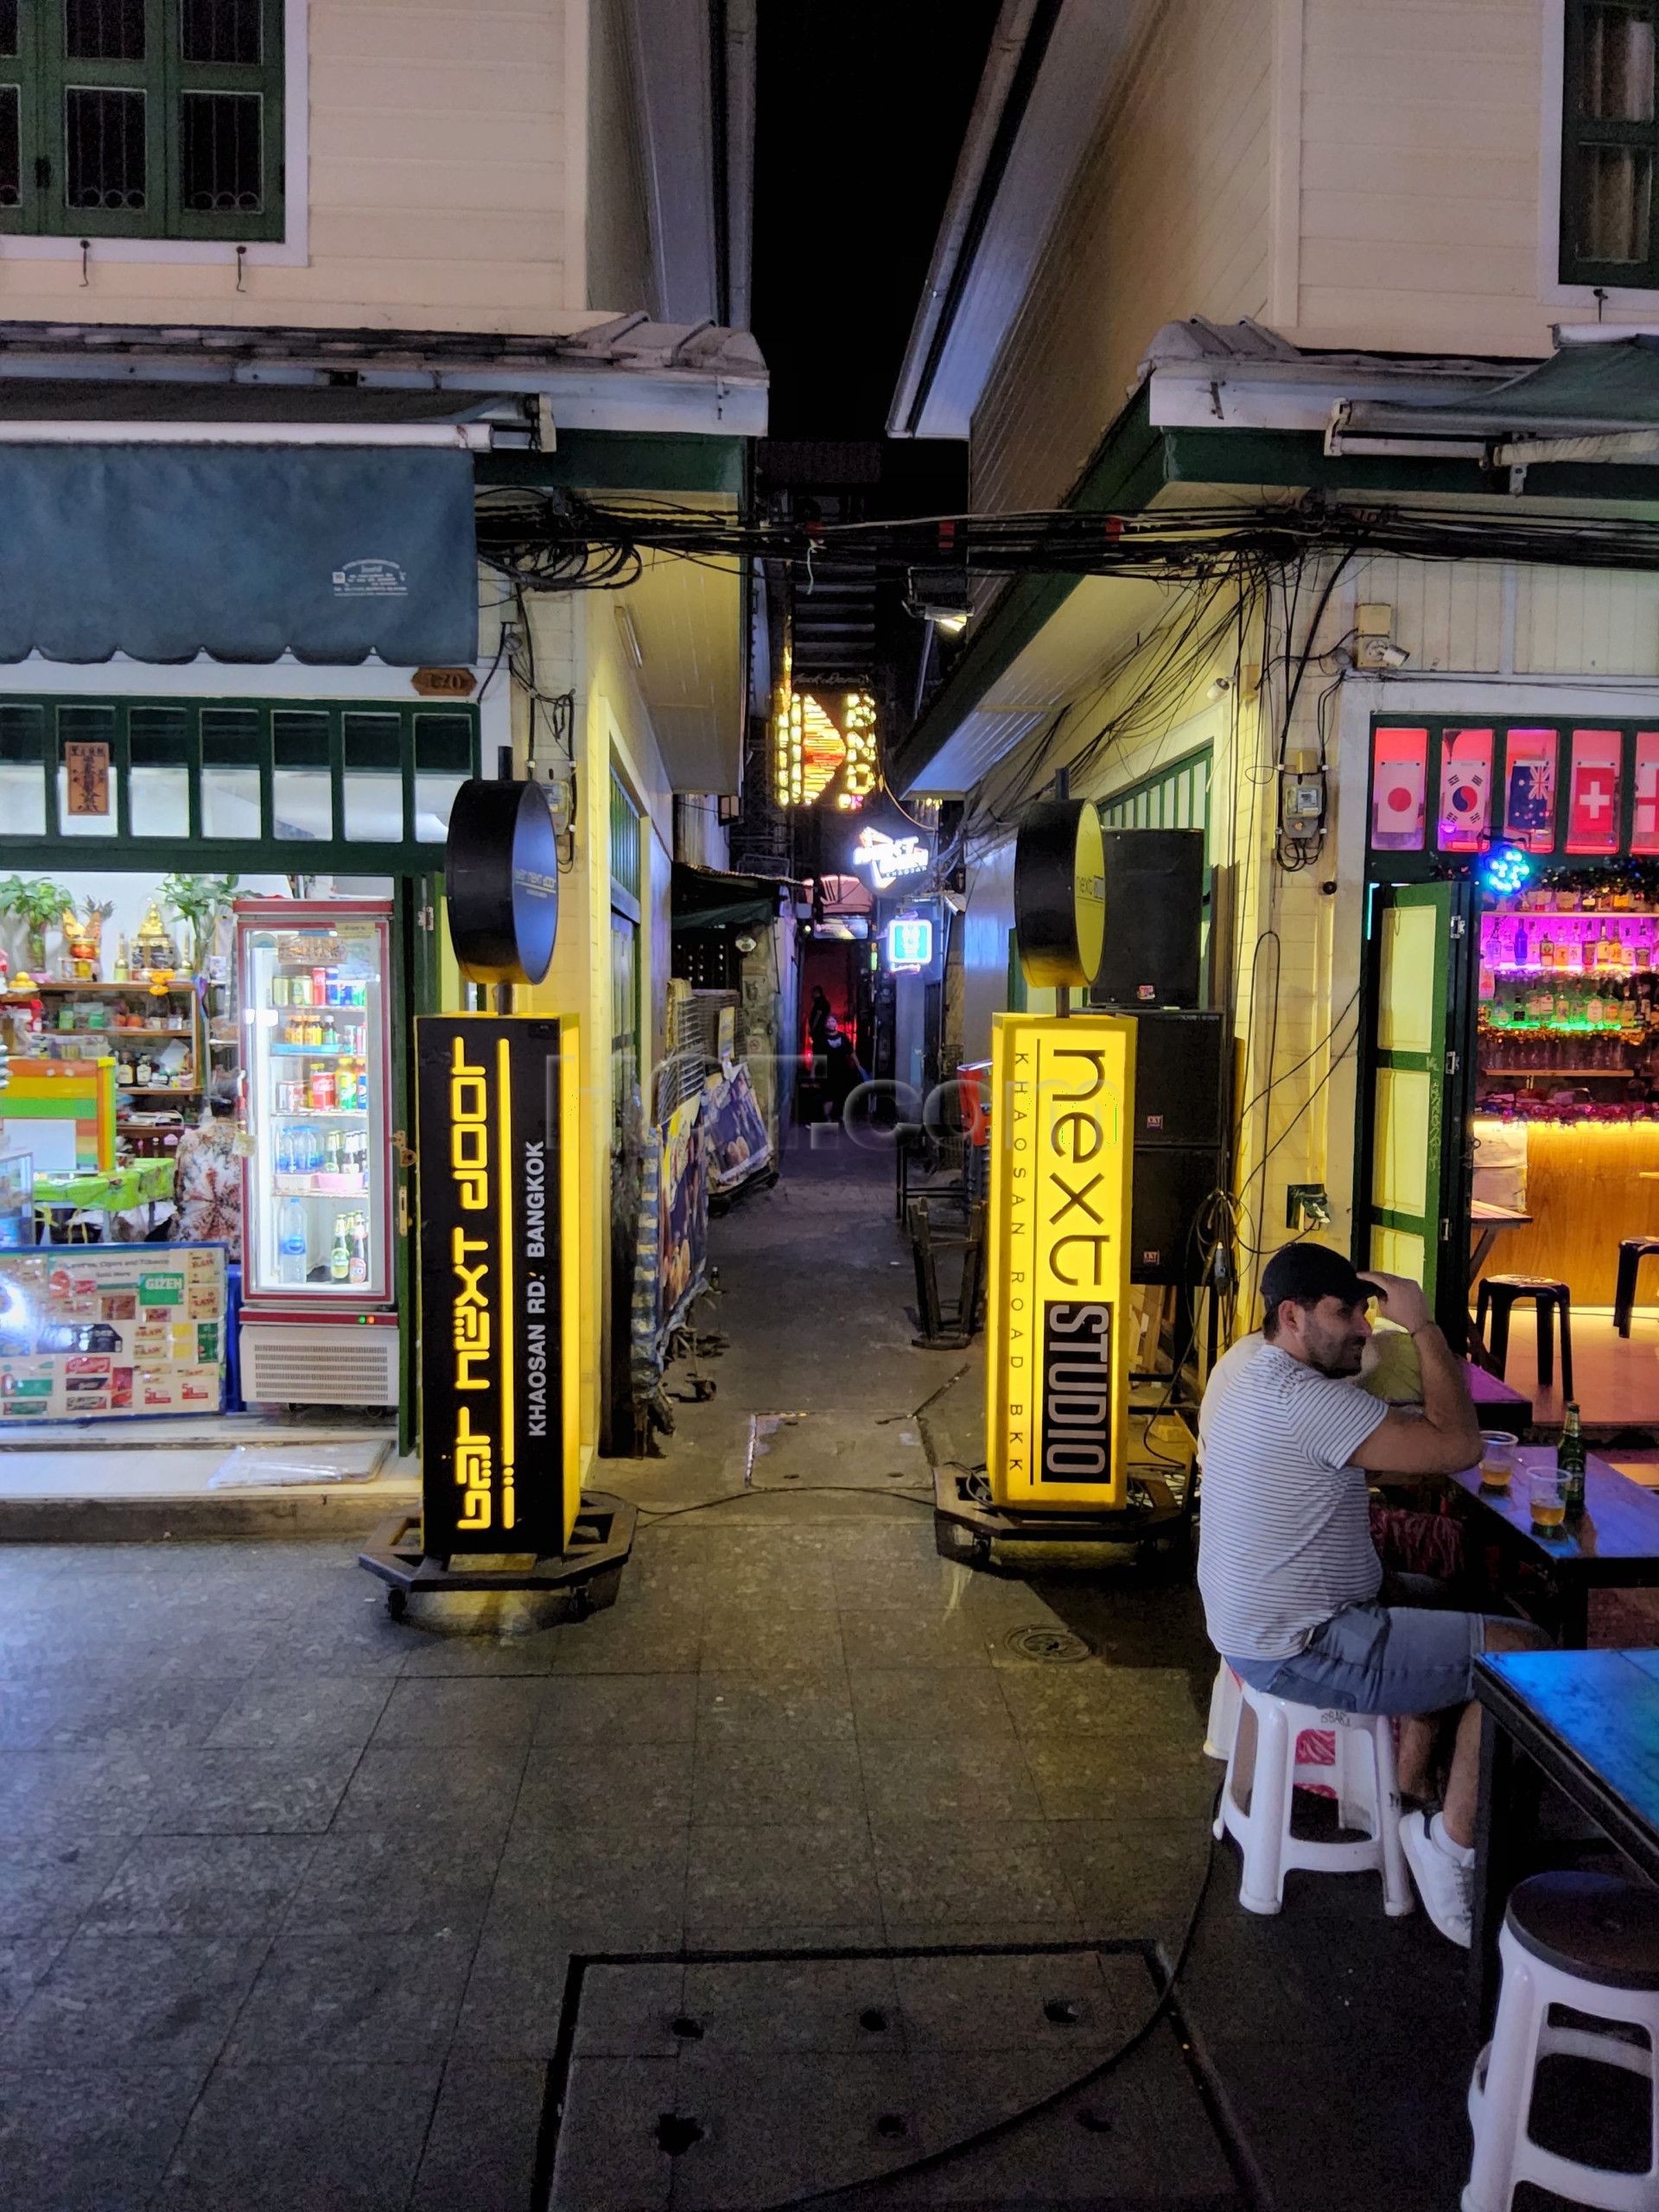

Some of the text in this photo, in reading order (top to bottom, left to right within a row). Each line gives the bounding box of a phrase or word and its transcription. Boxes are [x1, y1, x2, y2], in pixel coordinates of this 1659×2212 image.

[450, 1036, 489, 1210] door
[525, 1141, 545, 1258] BANGKOK
[1008, 1052, 1029, 1471] KHAOSAN ROAD BKK
[1046, 1048, 1110, 1475] next STUDIO
[145, 1278, 184, 1290] GIZEH
[527, 1324, 547, 1436] KHAOSAN
